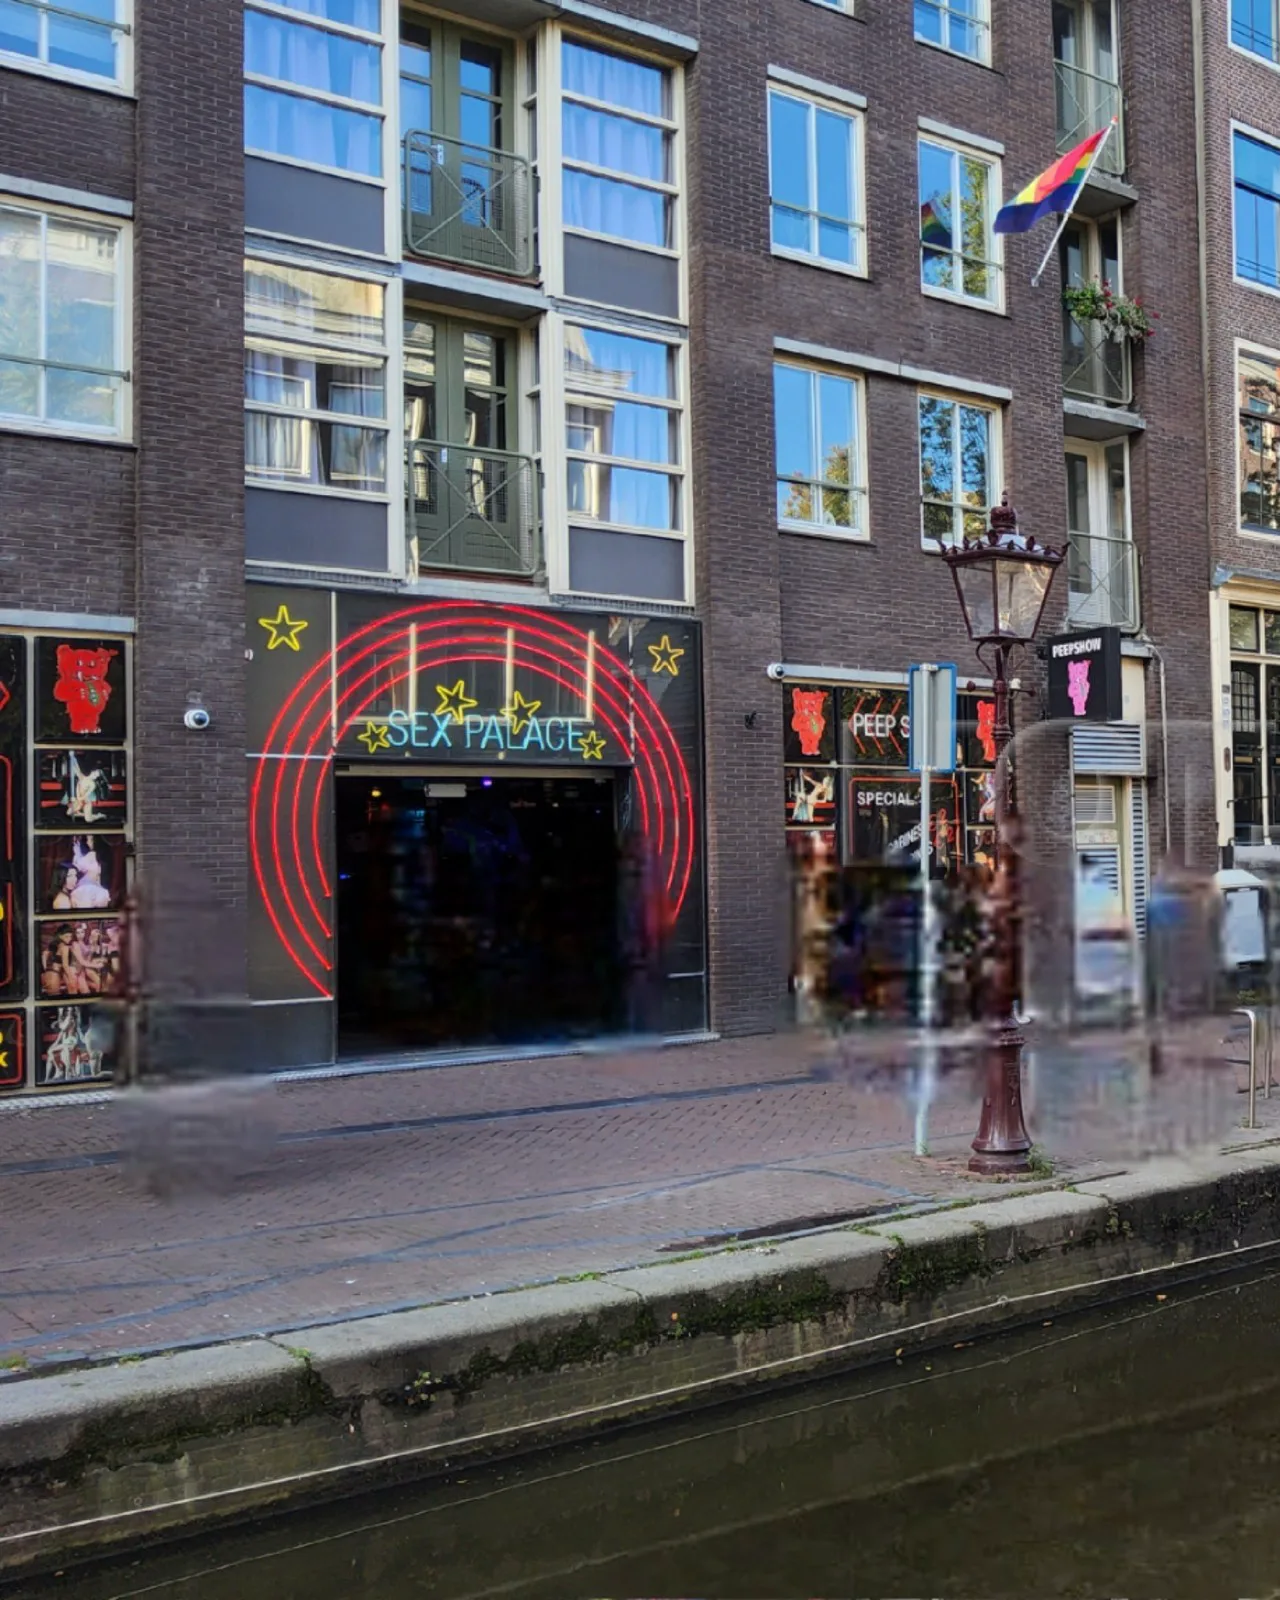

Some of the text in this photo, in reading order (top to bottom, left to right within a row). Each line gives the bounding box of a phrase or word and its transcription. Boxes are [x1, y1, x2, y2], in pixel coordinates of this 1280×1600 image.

[1052, 638, 1102, 658] PEEPSHOW
[387, 710, 584, 752] SEX PALACE
[852, 712, 896, 738] PEEP
[857, 791, 915, 806] SPECIAL
